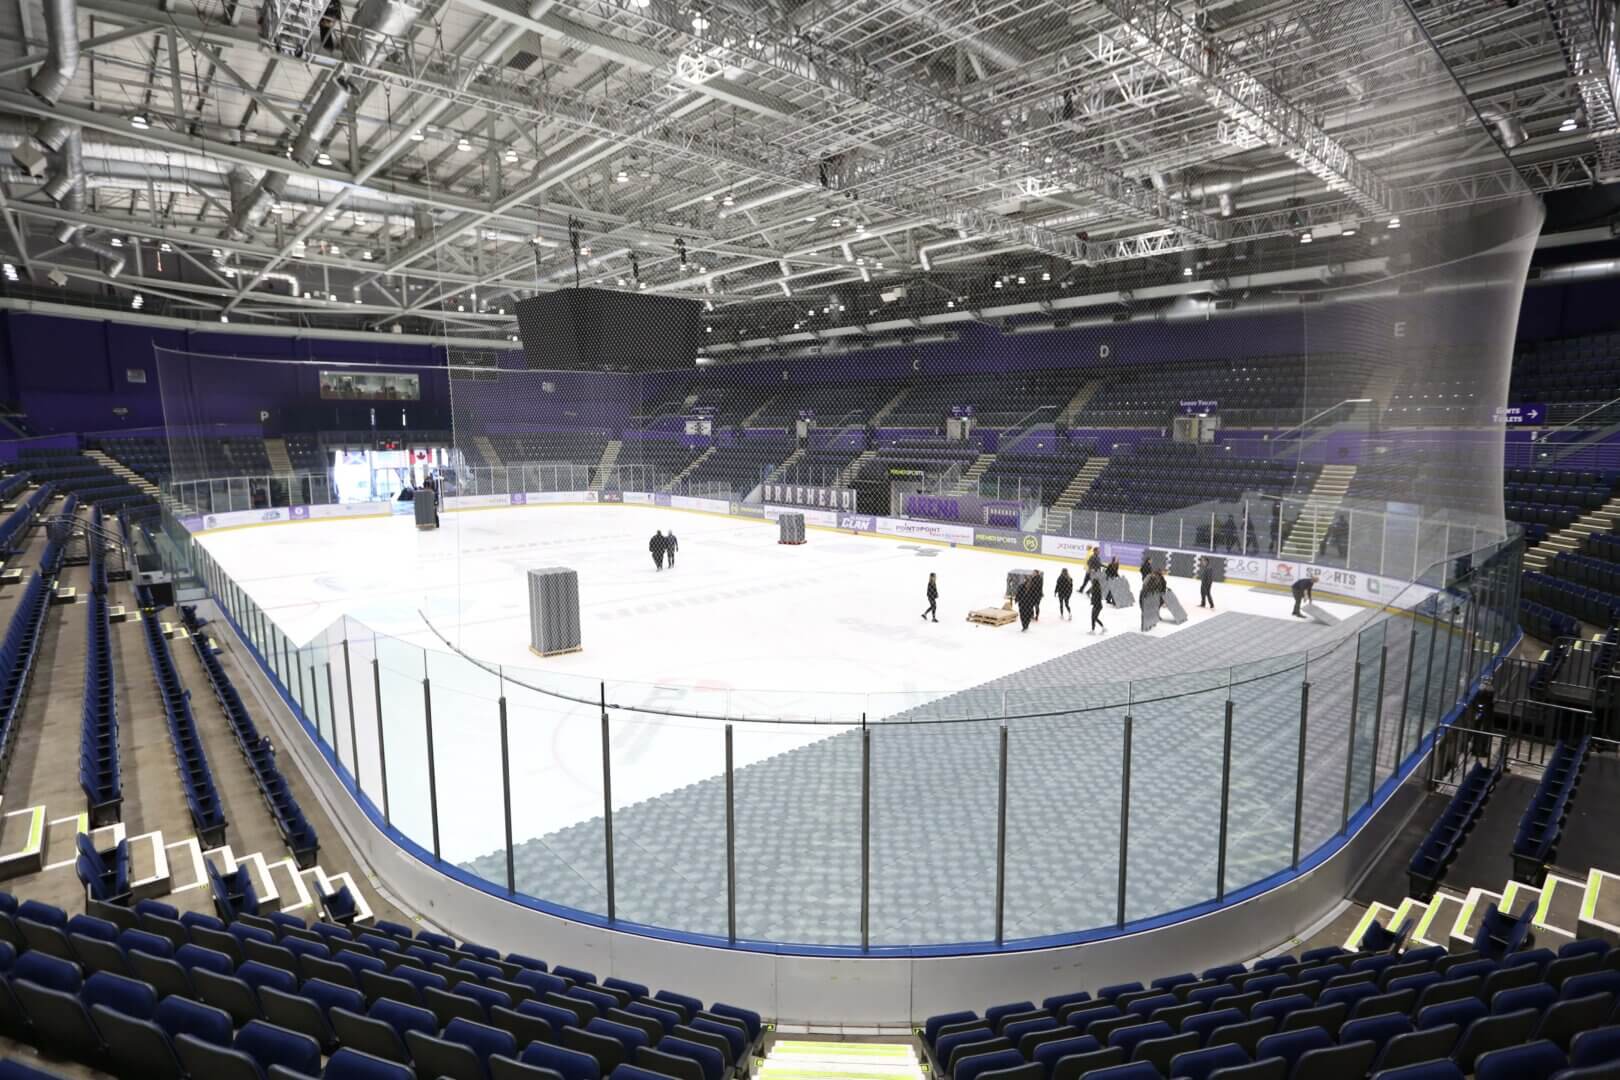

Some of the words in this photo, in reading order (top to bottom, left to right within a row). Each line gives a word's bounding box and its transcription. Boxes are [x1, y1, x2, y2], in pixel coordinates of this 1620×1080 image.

[1100, 344, 1110, 358] D
[260, 410, 270, 422] P
[764, 485, 850, 508] BRAEHEAD
[841, 517, 870, 531] CLAN
